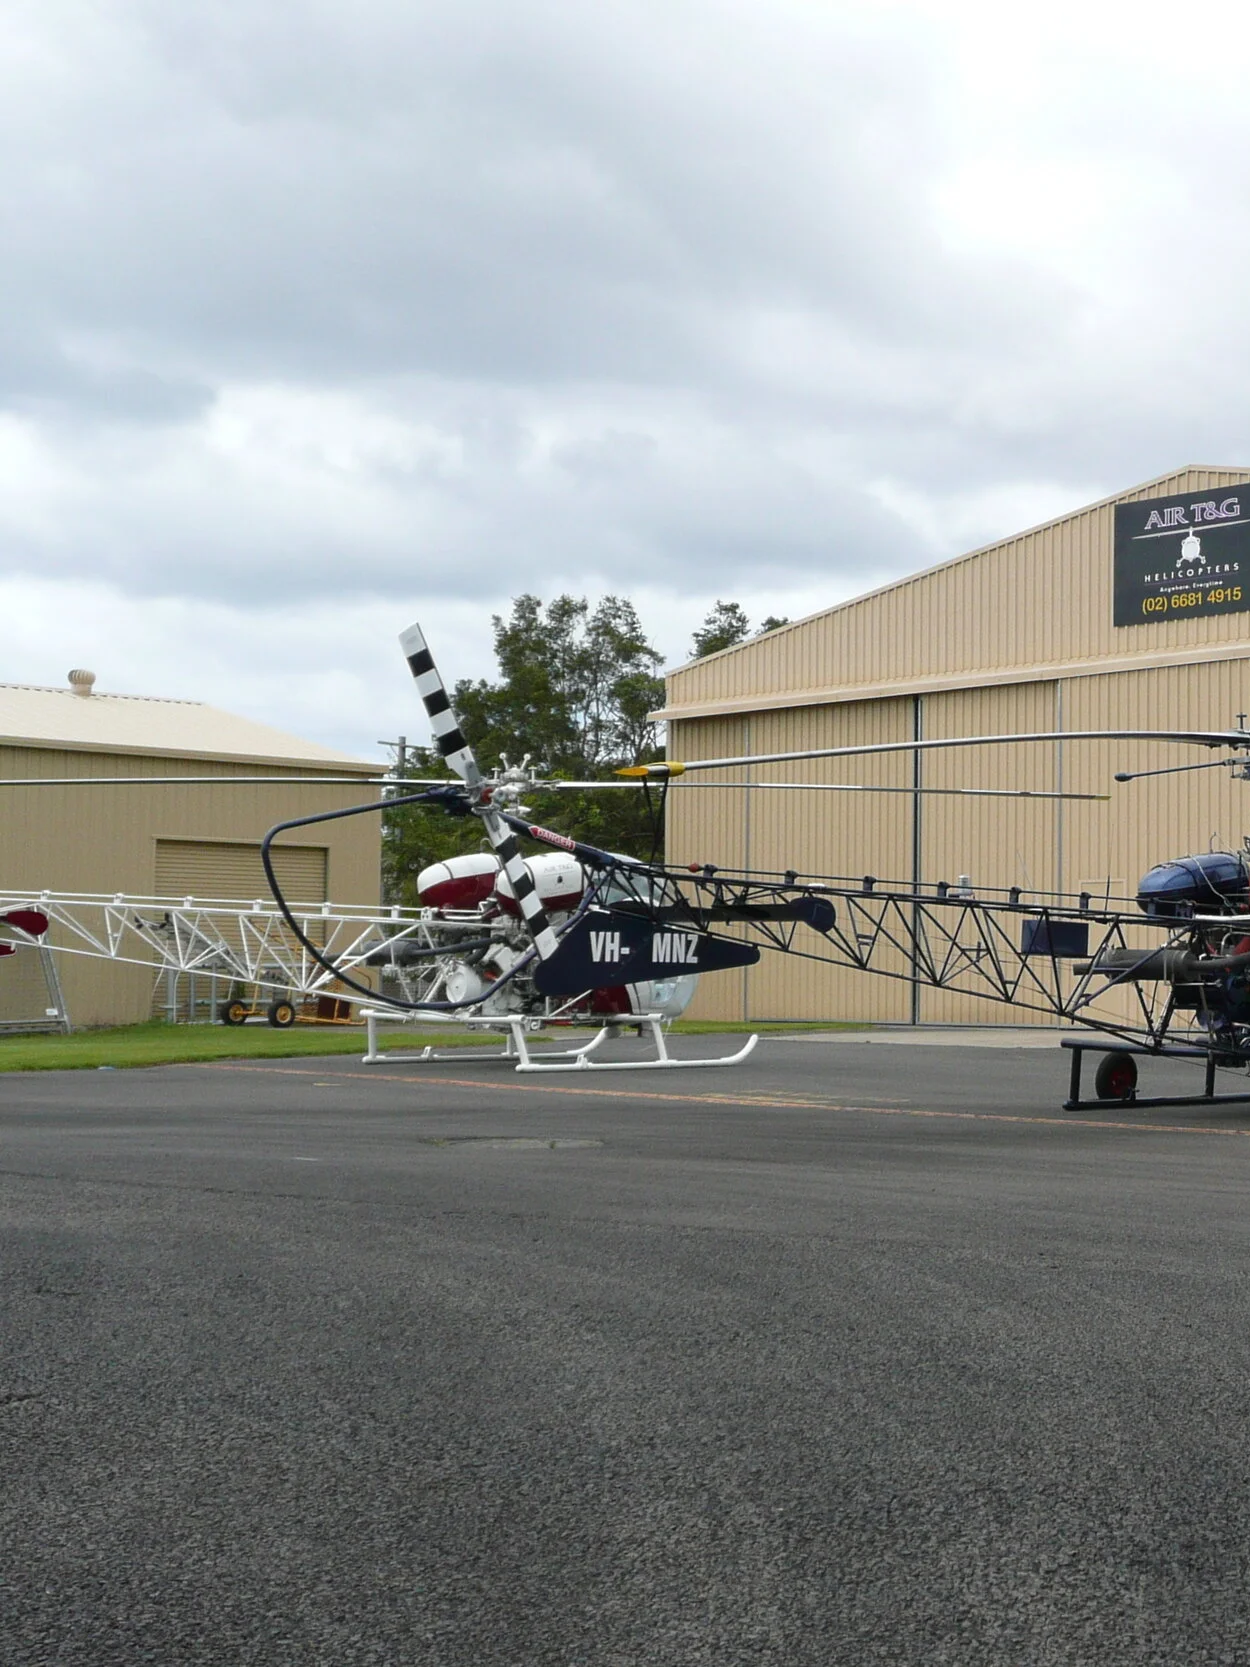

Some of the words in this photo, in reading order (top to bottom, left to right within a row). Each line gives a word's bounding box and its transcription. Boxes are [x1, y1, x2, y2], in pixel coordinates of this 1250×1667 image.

[1144, 506, 1189, 530] AIR
[1190, 497, 1241, 522] T&G
[1144, 562, 1240, 583] HELICOPTERS
[1142, 597, 1168, 615] (02)
[1171, 592, 1203, 608] 6681
[1207, 587, 1242, 604] 4915
[537, 829, 573, 849] DANGER
[589, 931, 631, 963] VH-
[652, 932, 699, 964] MNZ
